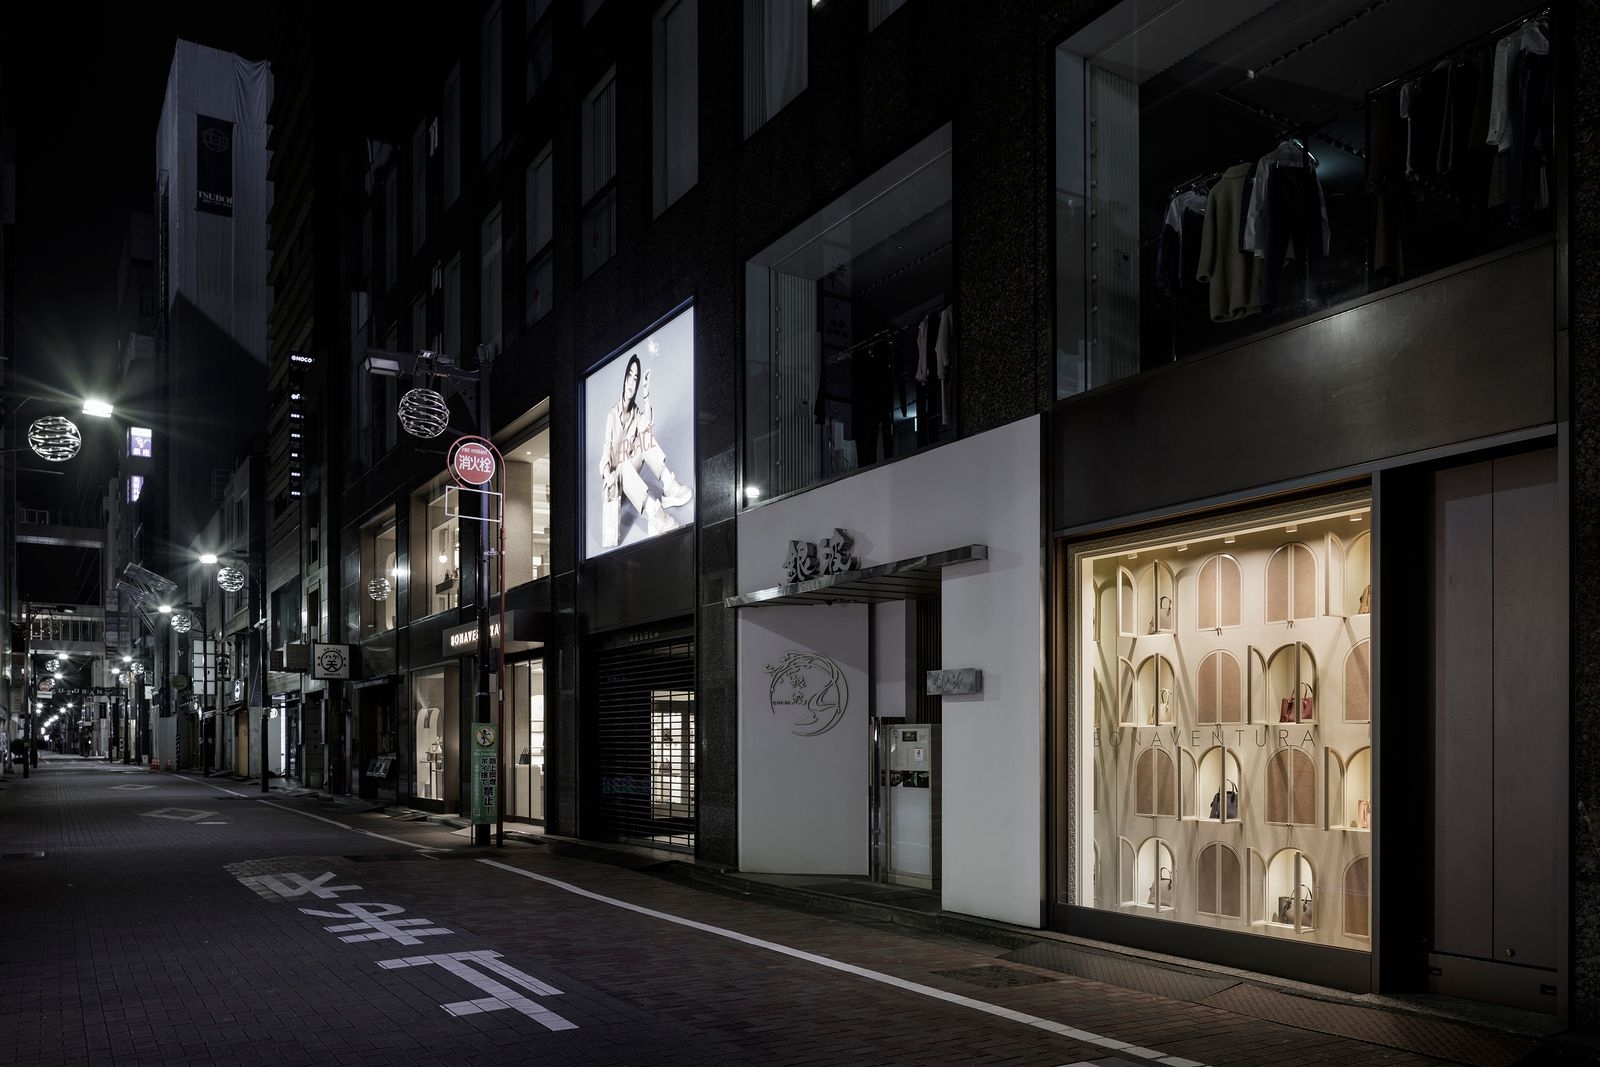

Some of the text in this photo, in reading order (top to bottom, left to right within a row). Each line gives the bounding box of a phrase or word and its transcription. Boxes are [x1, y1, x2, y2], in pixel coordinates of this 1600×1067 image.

[459, 454, 492, 473] 消火栓
[450, 622, 500, 647] BONAVERA
[1093, 729, 1316, 748] BONAVENTURA
